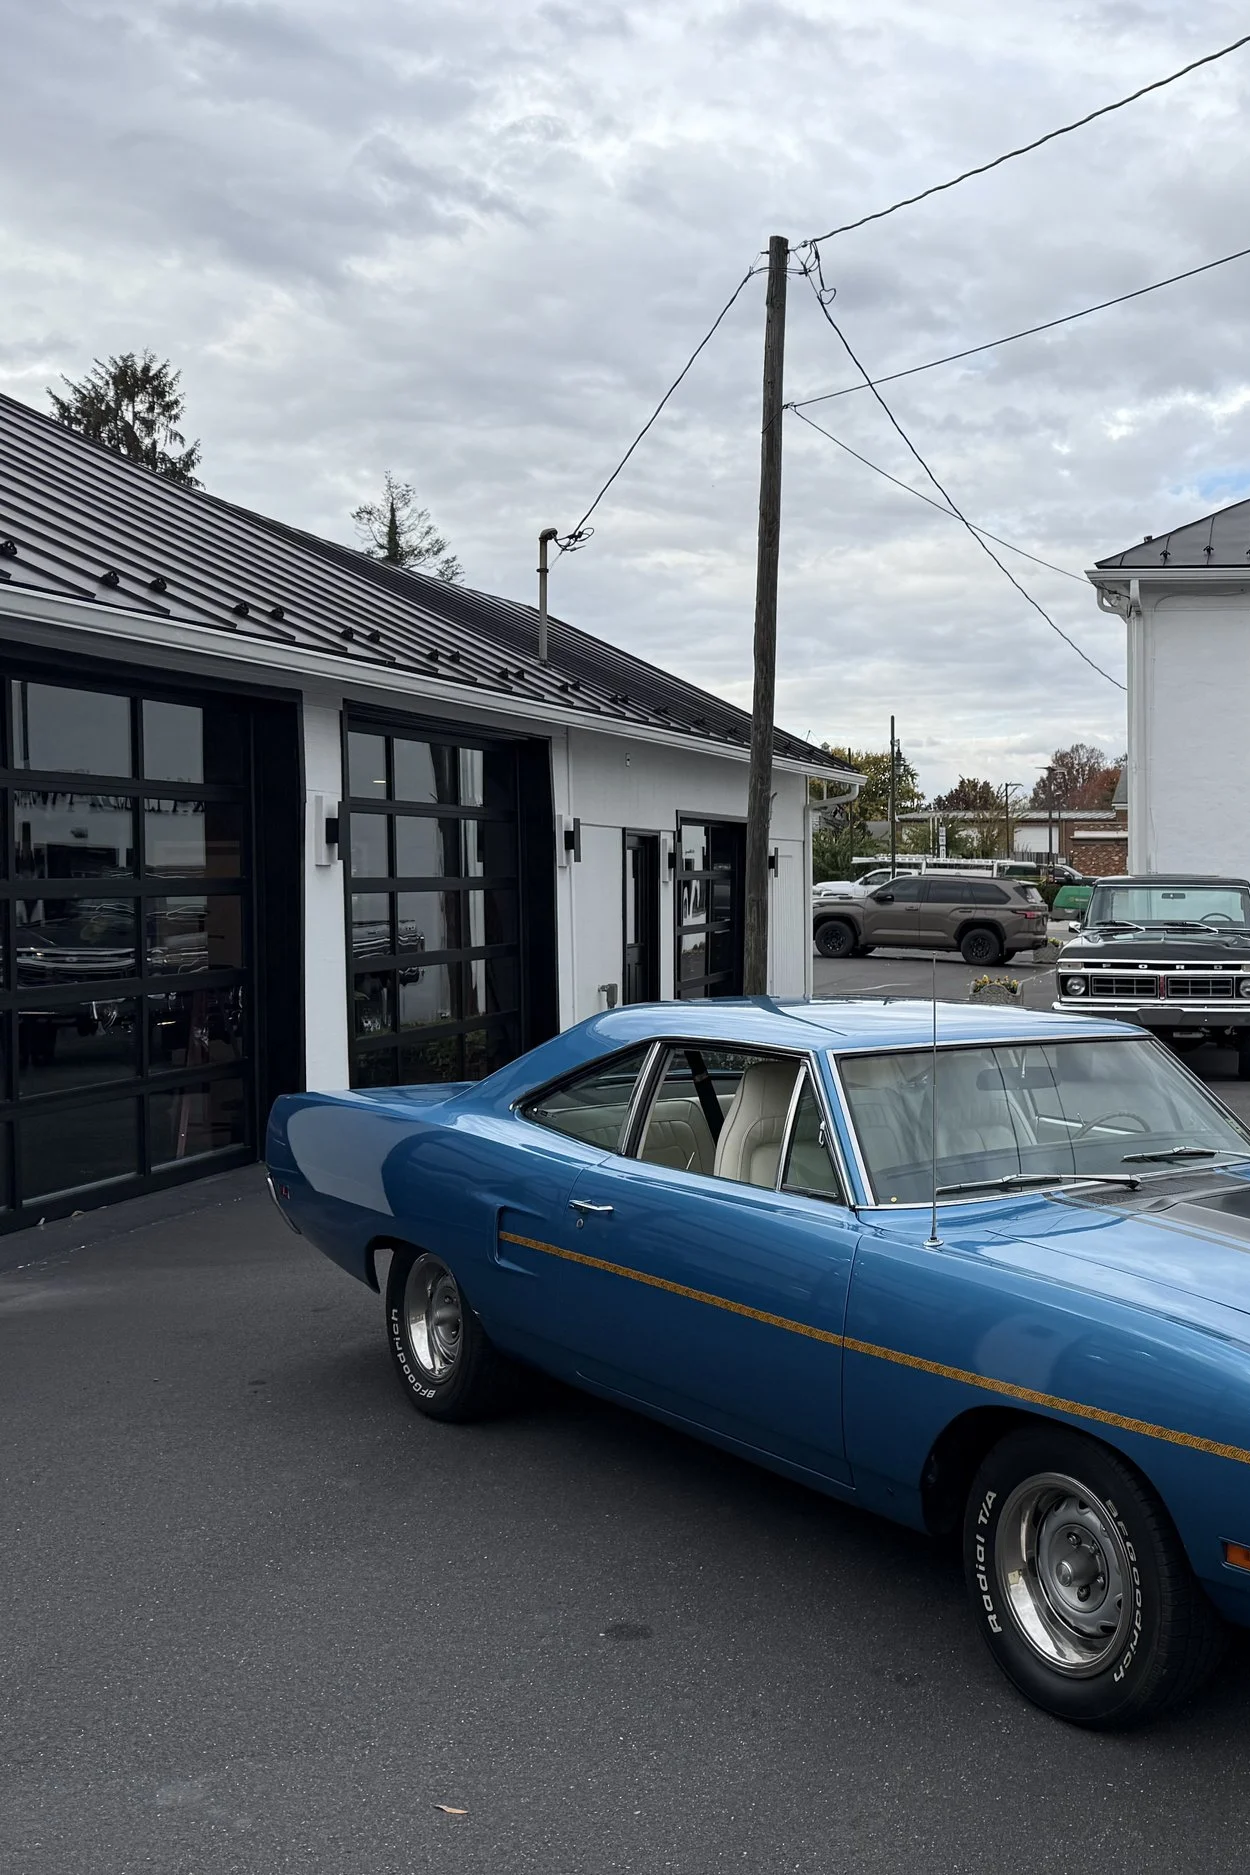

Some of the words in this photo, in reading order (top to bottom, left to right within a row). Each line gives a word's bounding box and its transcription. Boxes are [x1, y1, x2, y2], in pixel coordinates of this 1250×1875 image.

[391, 1308, 436, 1398] BFGoodrich
[977, 1490, 997, 1525] T/A
[975, 1534, 1003, 1633] Radial
[1105, 1499, 1143, 1683] BFGoodrich
